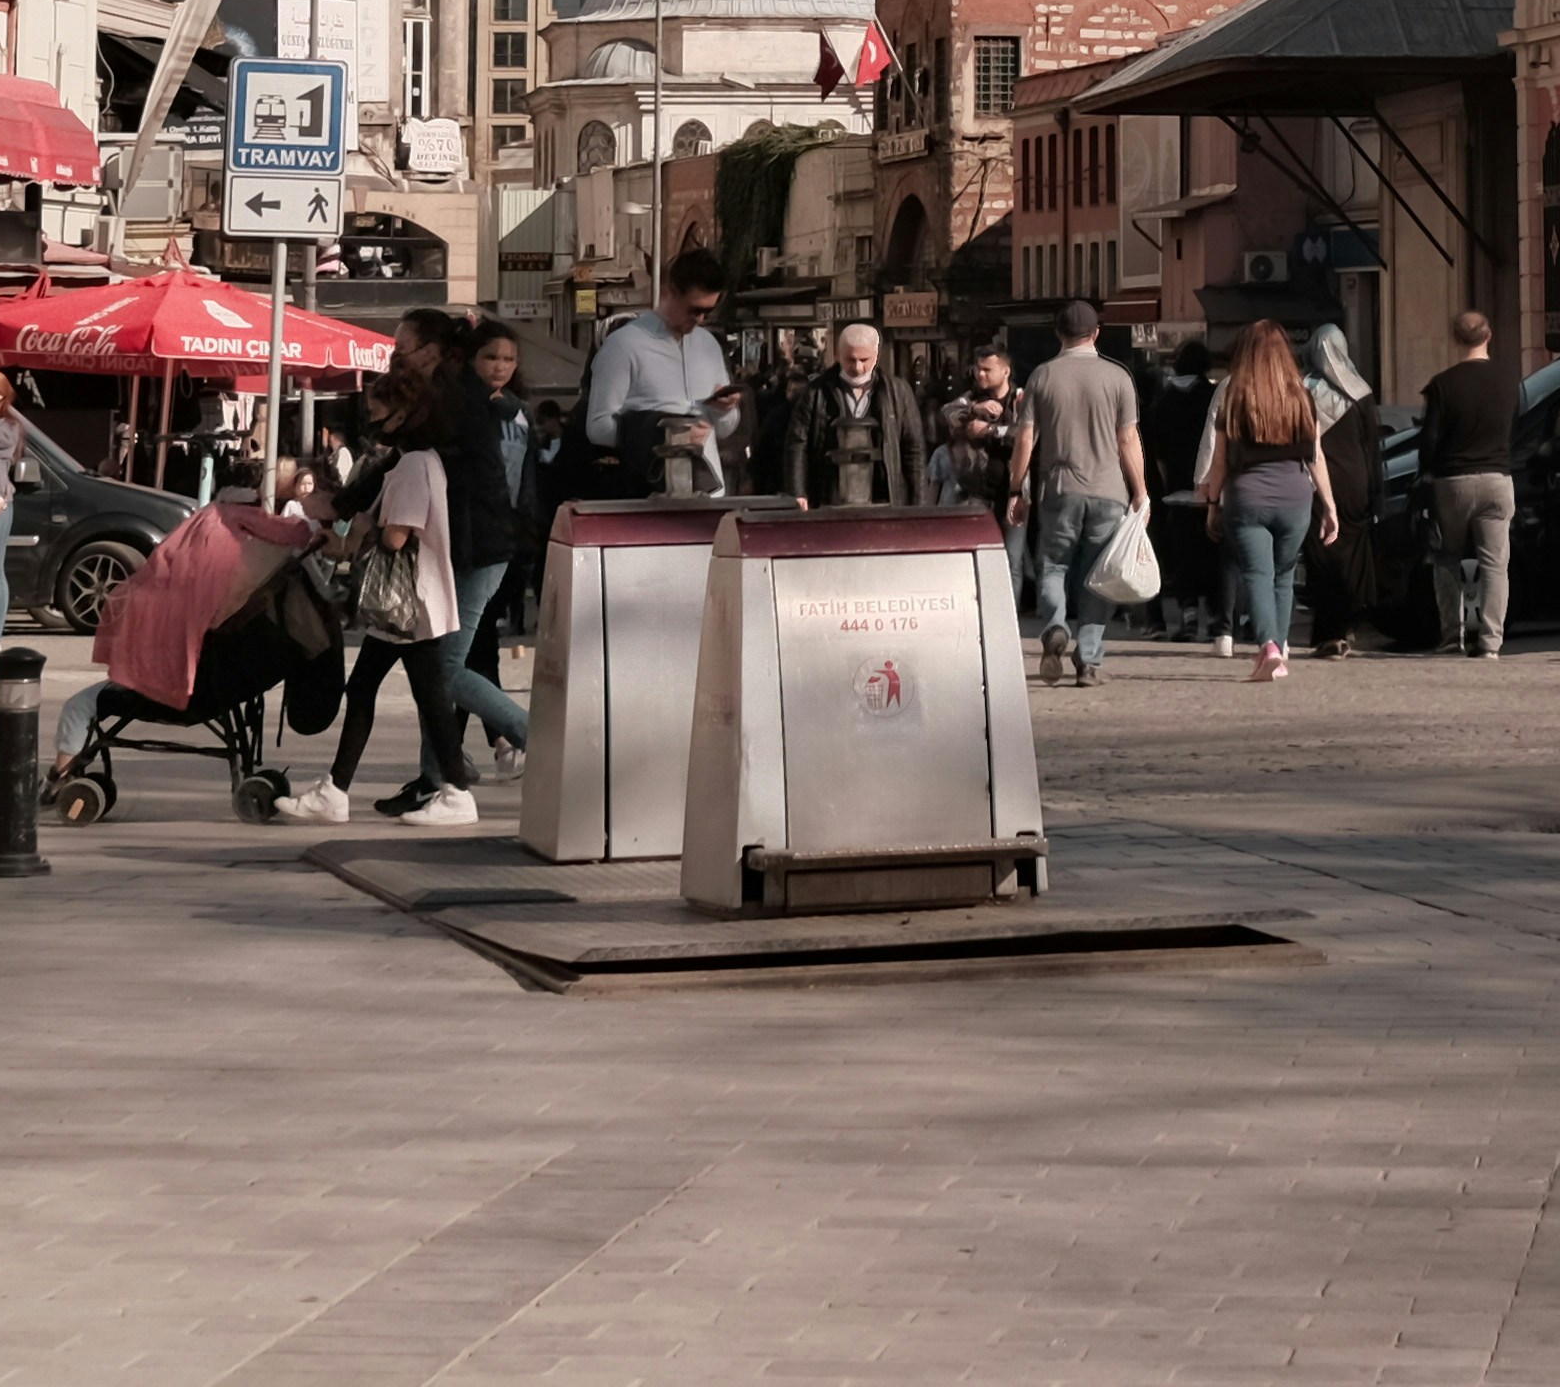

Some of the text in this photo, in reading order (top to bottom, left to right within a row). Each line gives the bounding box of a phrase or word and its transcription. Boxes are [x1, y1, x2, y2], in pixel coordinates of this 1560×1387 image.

[238, 147, 336, 167] TRAMVAY
[180, 336, 242, 355] TADINI
[799, 594, 955, 616] FATİH BELEDİYESİ
[840, 617, 918, 632] 444 0 176
